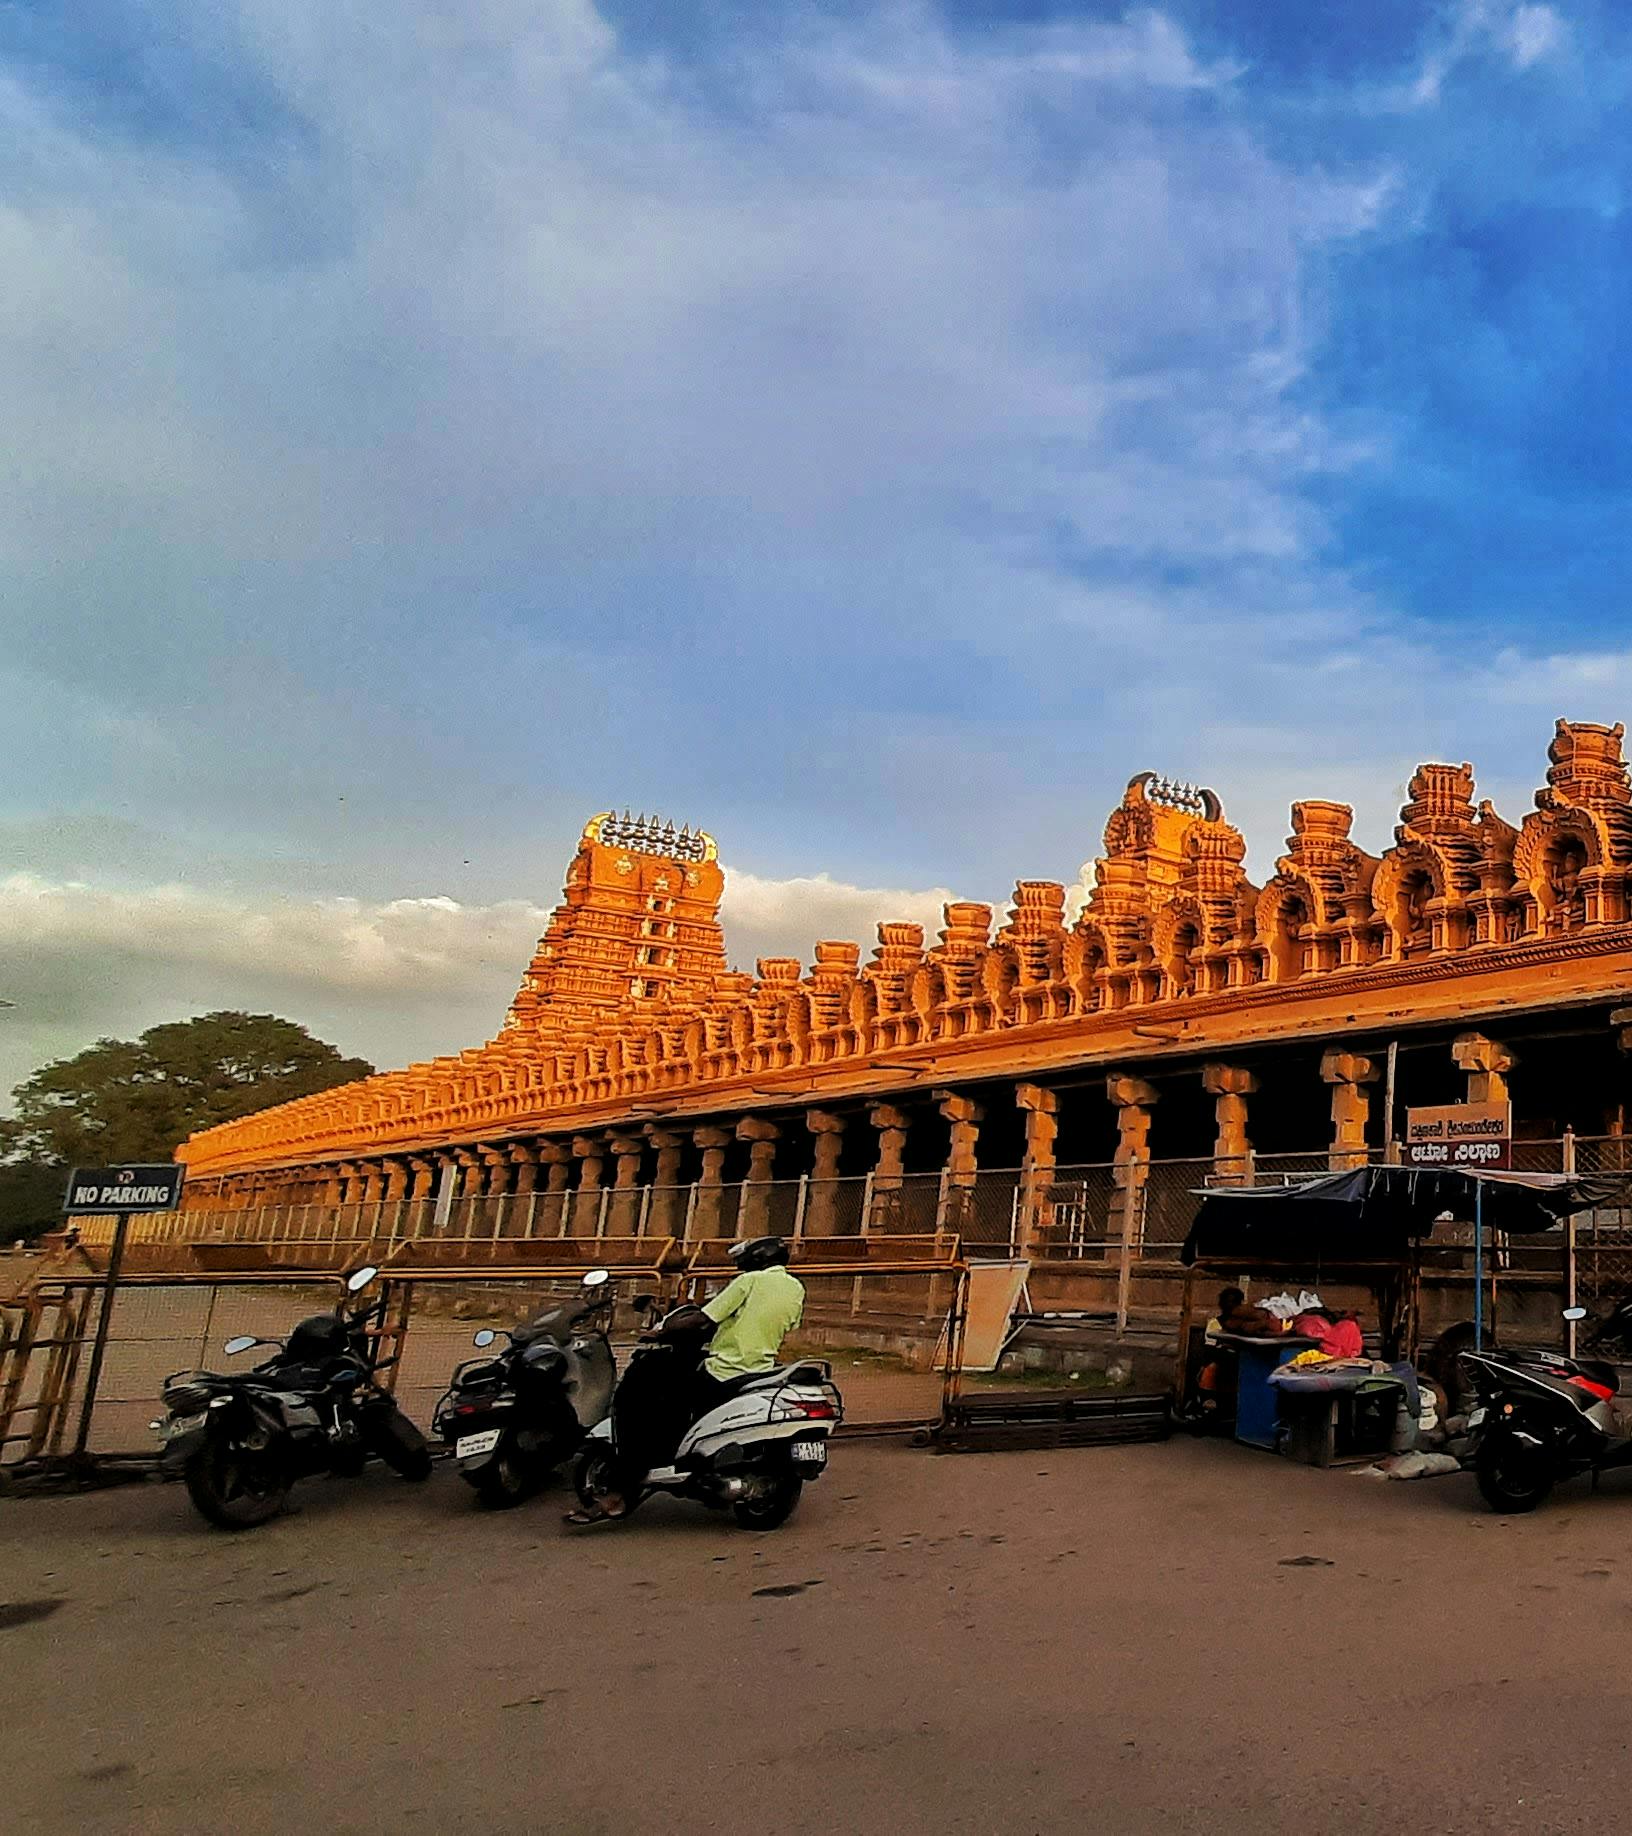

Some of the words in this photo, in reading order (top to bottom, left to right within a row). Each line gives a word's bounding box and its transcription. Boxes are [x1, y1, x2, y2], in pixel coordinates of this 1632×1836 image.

[1411, 1142, 1449, 1162] ಆಟೋ
[1454, 1143, 1501, 1164] ನಿಲ್ದಾಣ
[74, 1186, 99, 1204] NO
[99, 1185, 170, 1204] PARKING
